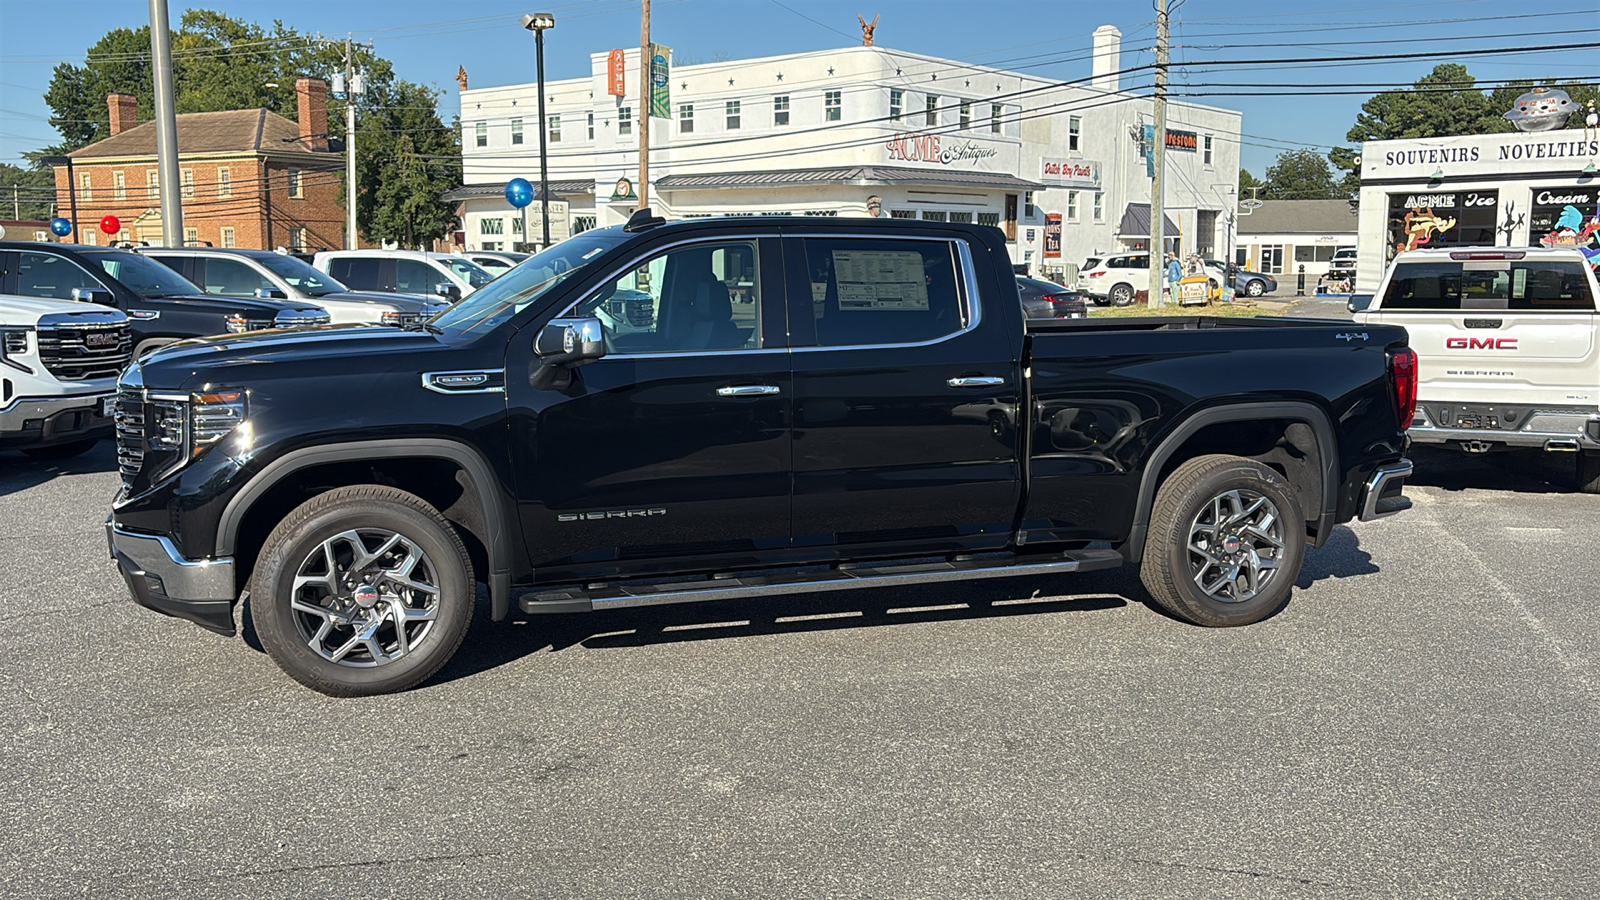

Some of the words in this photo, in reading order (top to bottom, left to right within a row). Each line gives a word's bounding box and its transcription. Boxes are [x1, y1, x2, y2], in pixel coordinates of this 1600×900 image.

[615, 52, 623, 92] ACME
[1165, 130, 1197, 148] irestone
[886, 132, 940, 163] ACME
[1386, 146, 1480, 166] SOUVENIRS
[1499, 140, 1599, 160] NOVELTIES
[1044, 162, 1060, 174] Dutch
[1062, 163, 1073, 178] Boy
[1073, 164, 1091, 177] Paints
[1404, 194, 1456, 208] ACME
[1464, 193, 1495, 207] Ice
[1536, 191, 1590, 205] Cream
[1048, 238, 1059, 250] TEA
[87, 333, 119, 346] GMC
[1446, 337, 1518, 350] GMC
[558, 507, 667, 521] SIERRA
[1170, 490, 1200, 546] BRIDGESTONE
